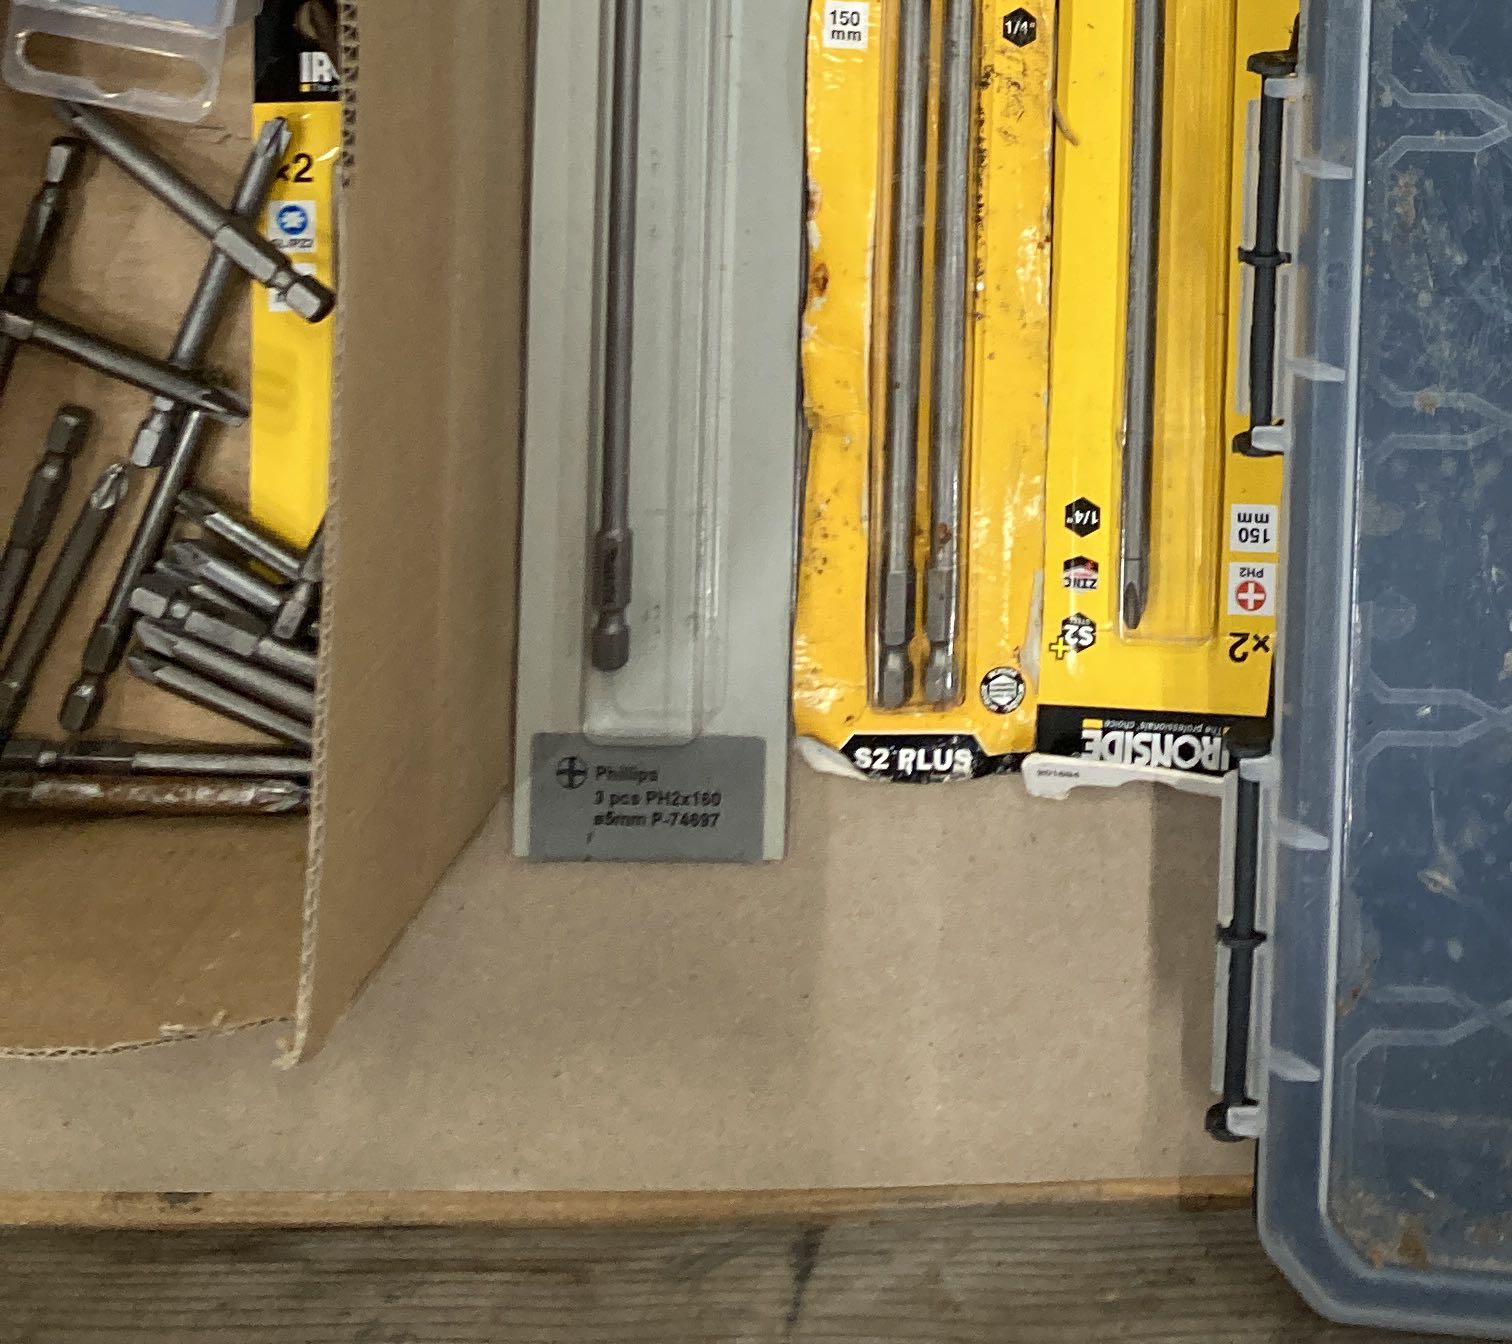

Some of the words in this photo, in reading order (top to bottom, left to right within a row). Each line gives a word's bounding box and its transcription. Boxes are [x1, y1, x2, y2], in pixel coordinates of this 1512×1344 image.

[830, 9, 860, 26] 150
[831, 28, 862, 41] mm
[1237, 512, 1268, 524] mm
[1238, 527, 1270, 542] 150
[1239, 567, 1263, 576] PH2
[1063, 577, 1096, 589] ZINC
[1104, 719, 1134, 727] choice
[854, 746, 891, 769] S2
[897, 748, 973, 775] PLUS
